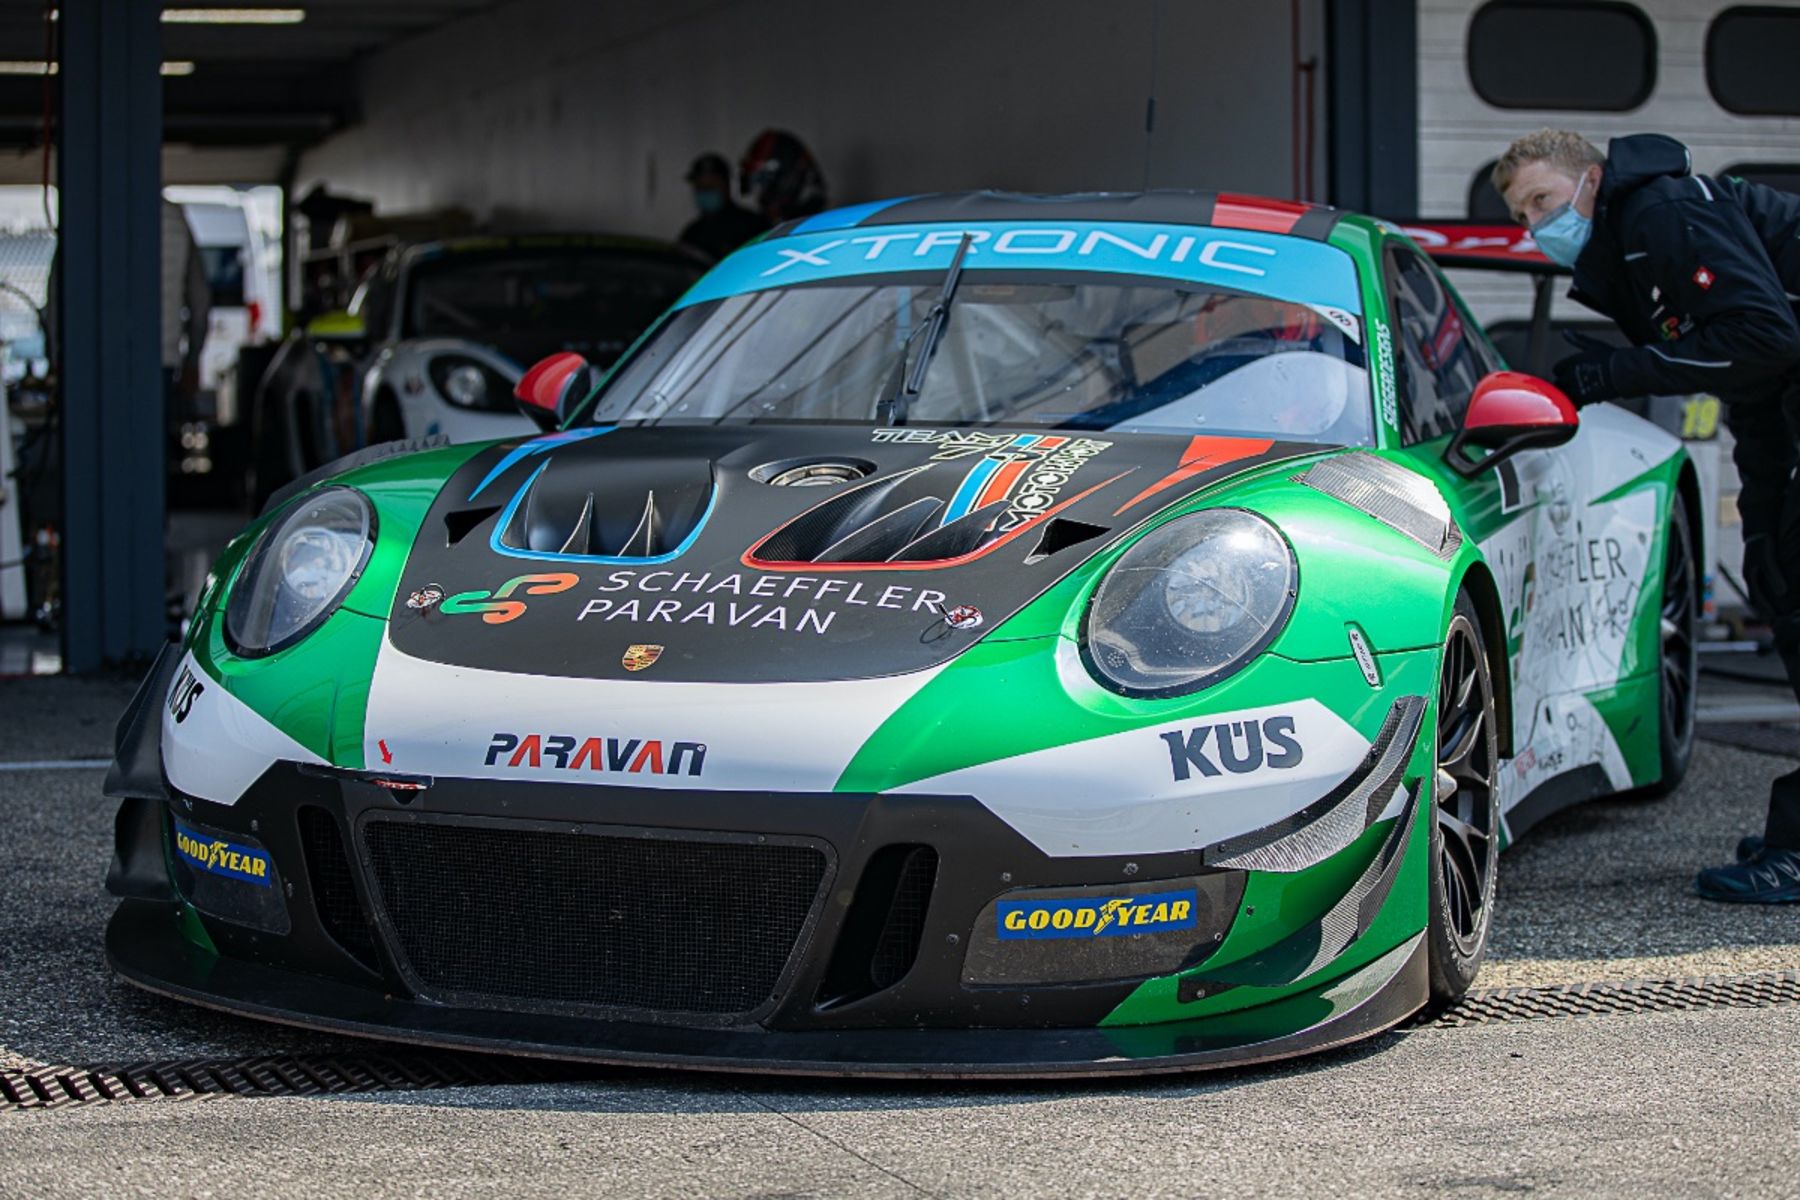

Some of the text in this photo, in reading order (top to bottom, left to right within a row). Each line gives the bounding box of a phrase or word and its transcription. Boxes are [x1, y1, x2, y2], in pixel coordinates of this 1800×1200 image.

[760, 229, 1277, 277] XTRONIC
[597, 571, 947, 614] SCHAEFFLER
[576, 600, 836, 634] PARAVAN
[484, 733, 707, 776] PARAVAN
[1159, 716, 1304, 781] KÜS
